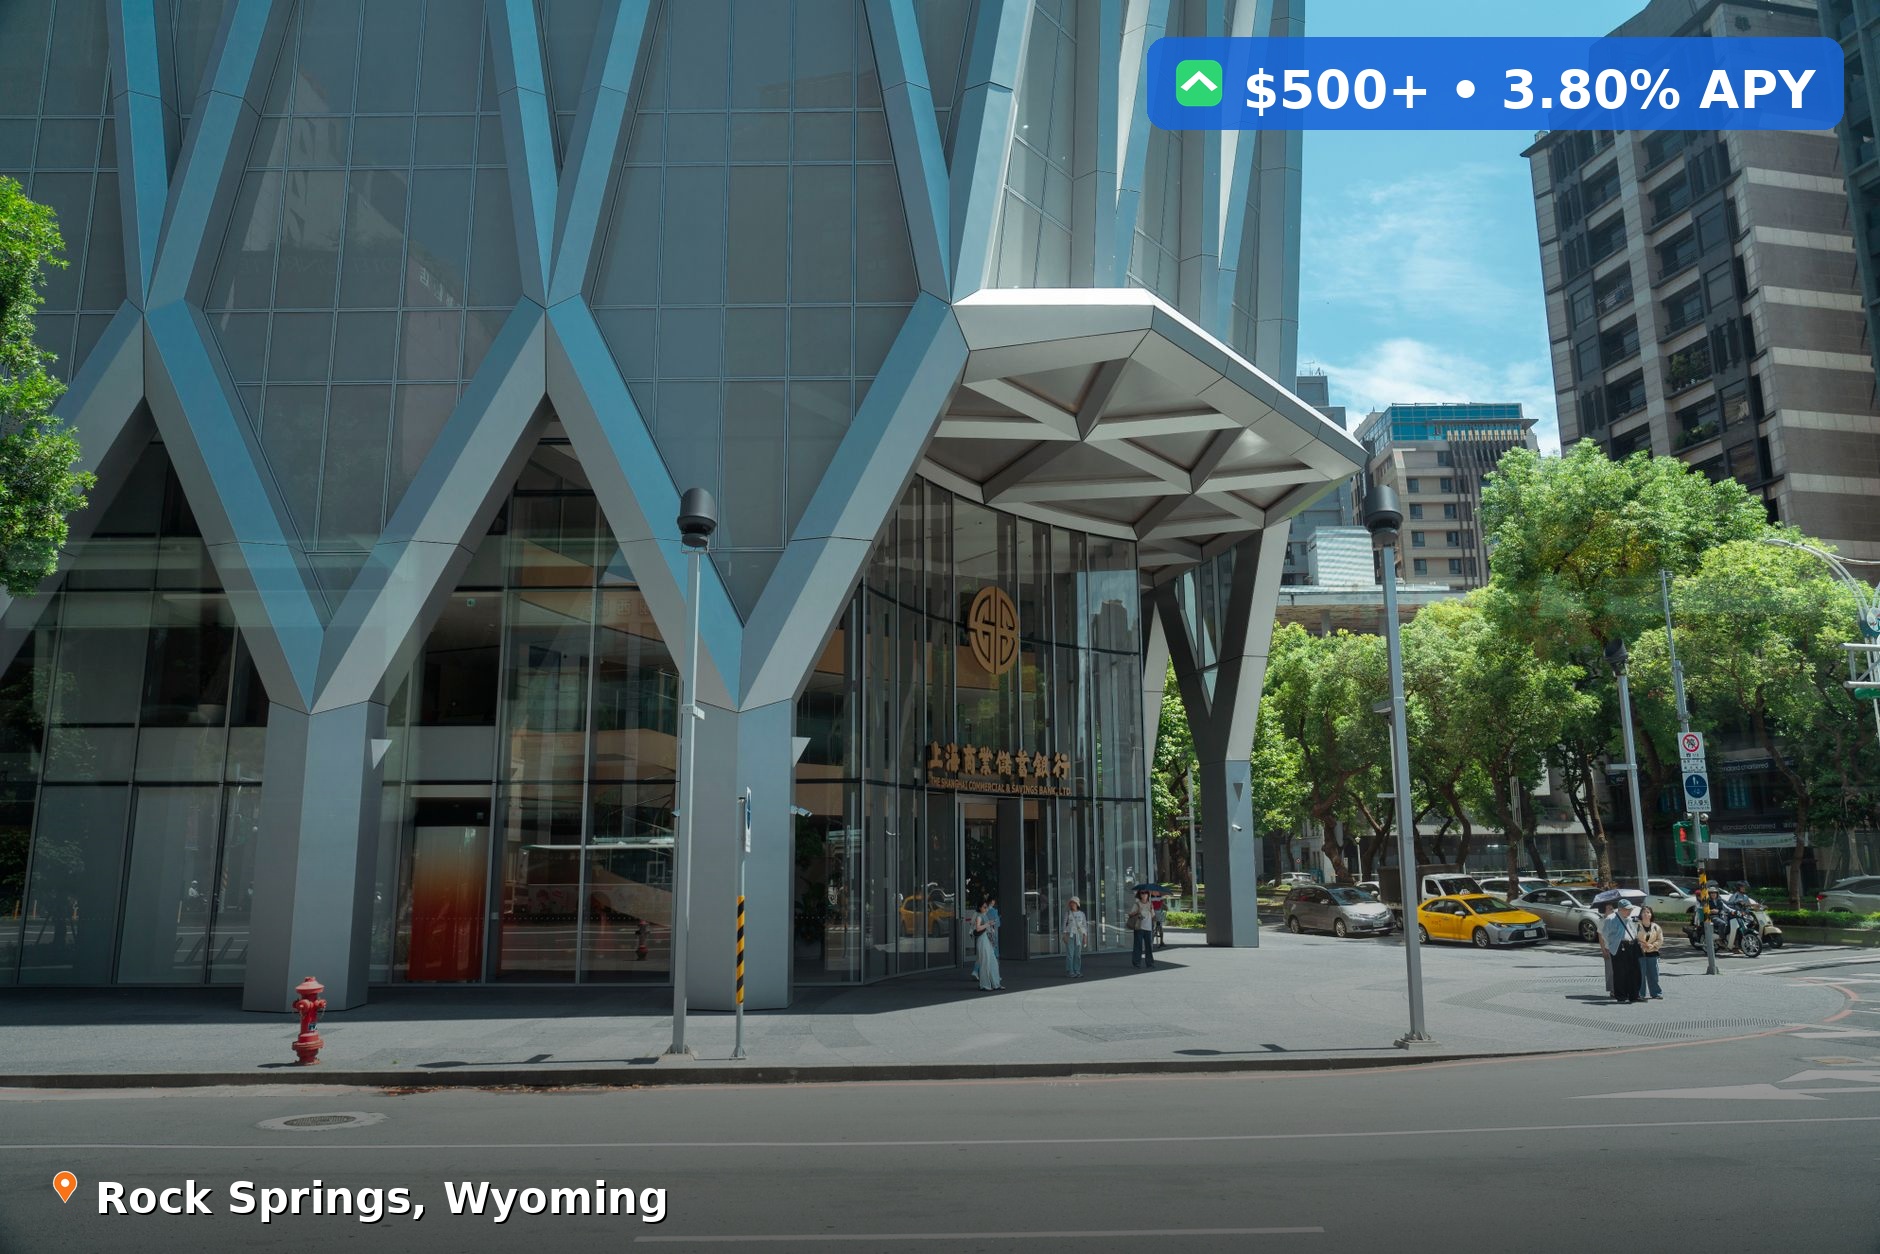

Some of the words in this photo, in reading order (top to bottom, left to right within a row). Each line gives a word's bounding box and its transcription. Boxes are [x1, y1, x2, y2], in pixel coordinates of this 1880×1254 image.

[941, 778, 968, 790] SHANGHAI
[969, 781, 1005, 792] COMMERCIAL
[1012, 784, 1038, 795] SAVINGS
